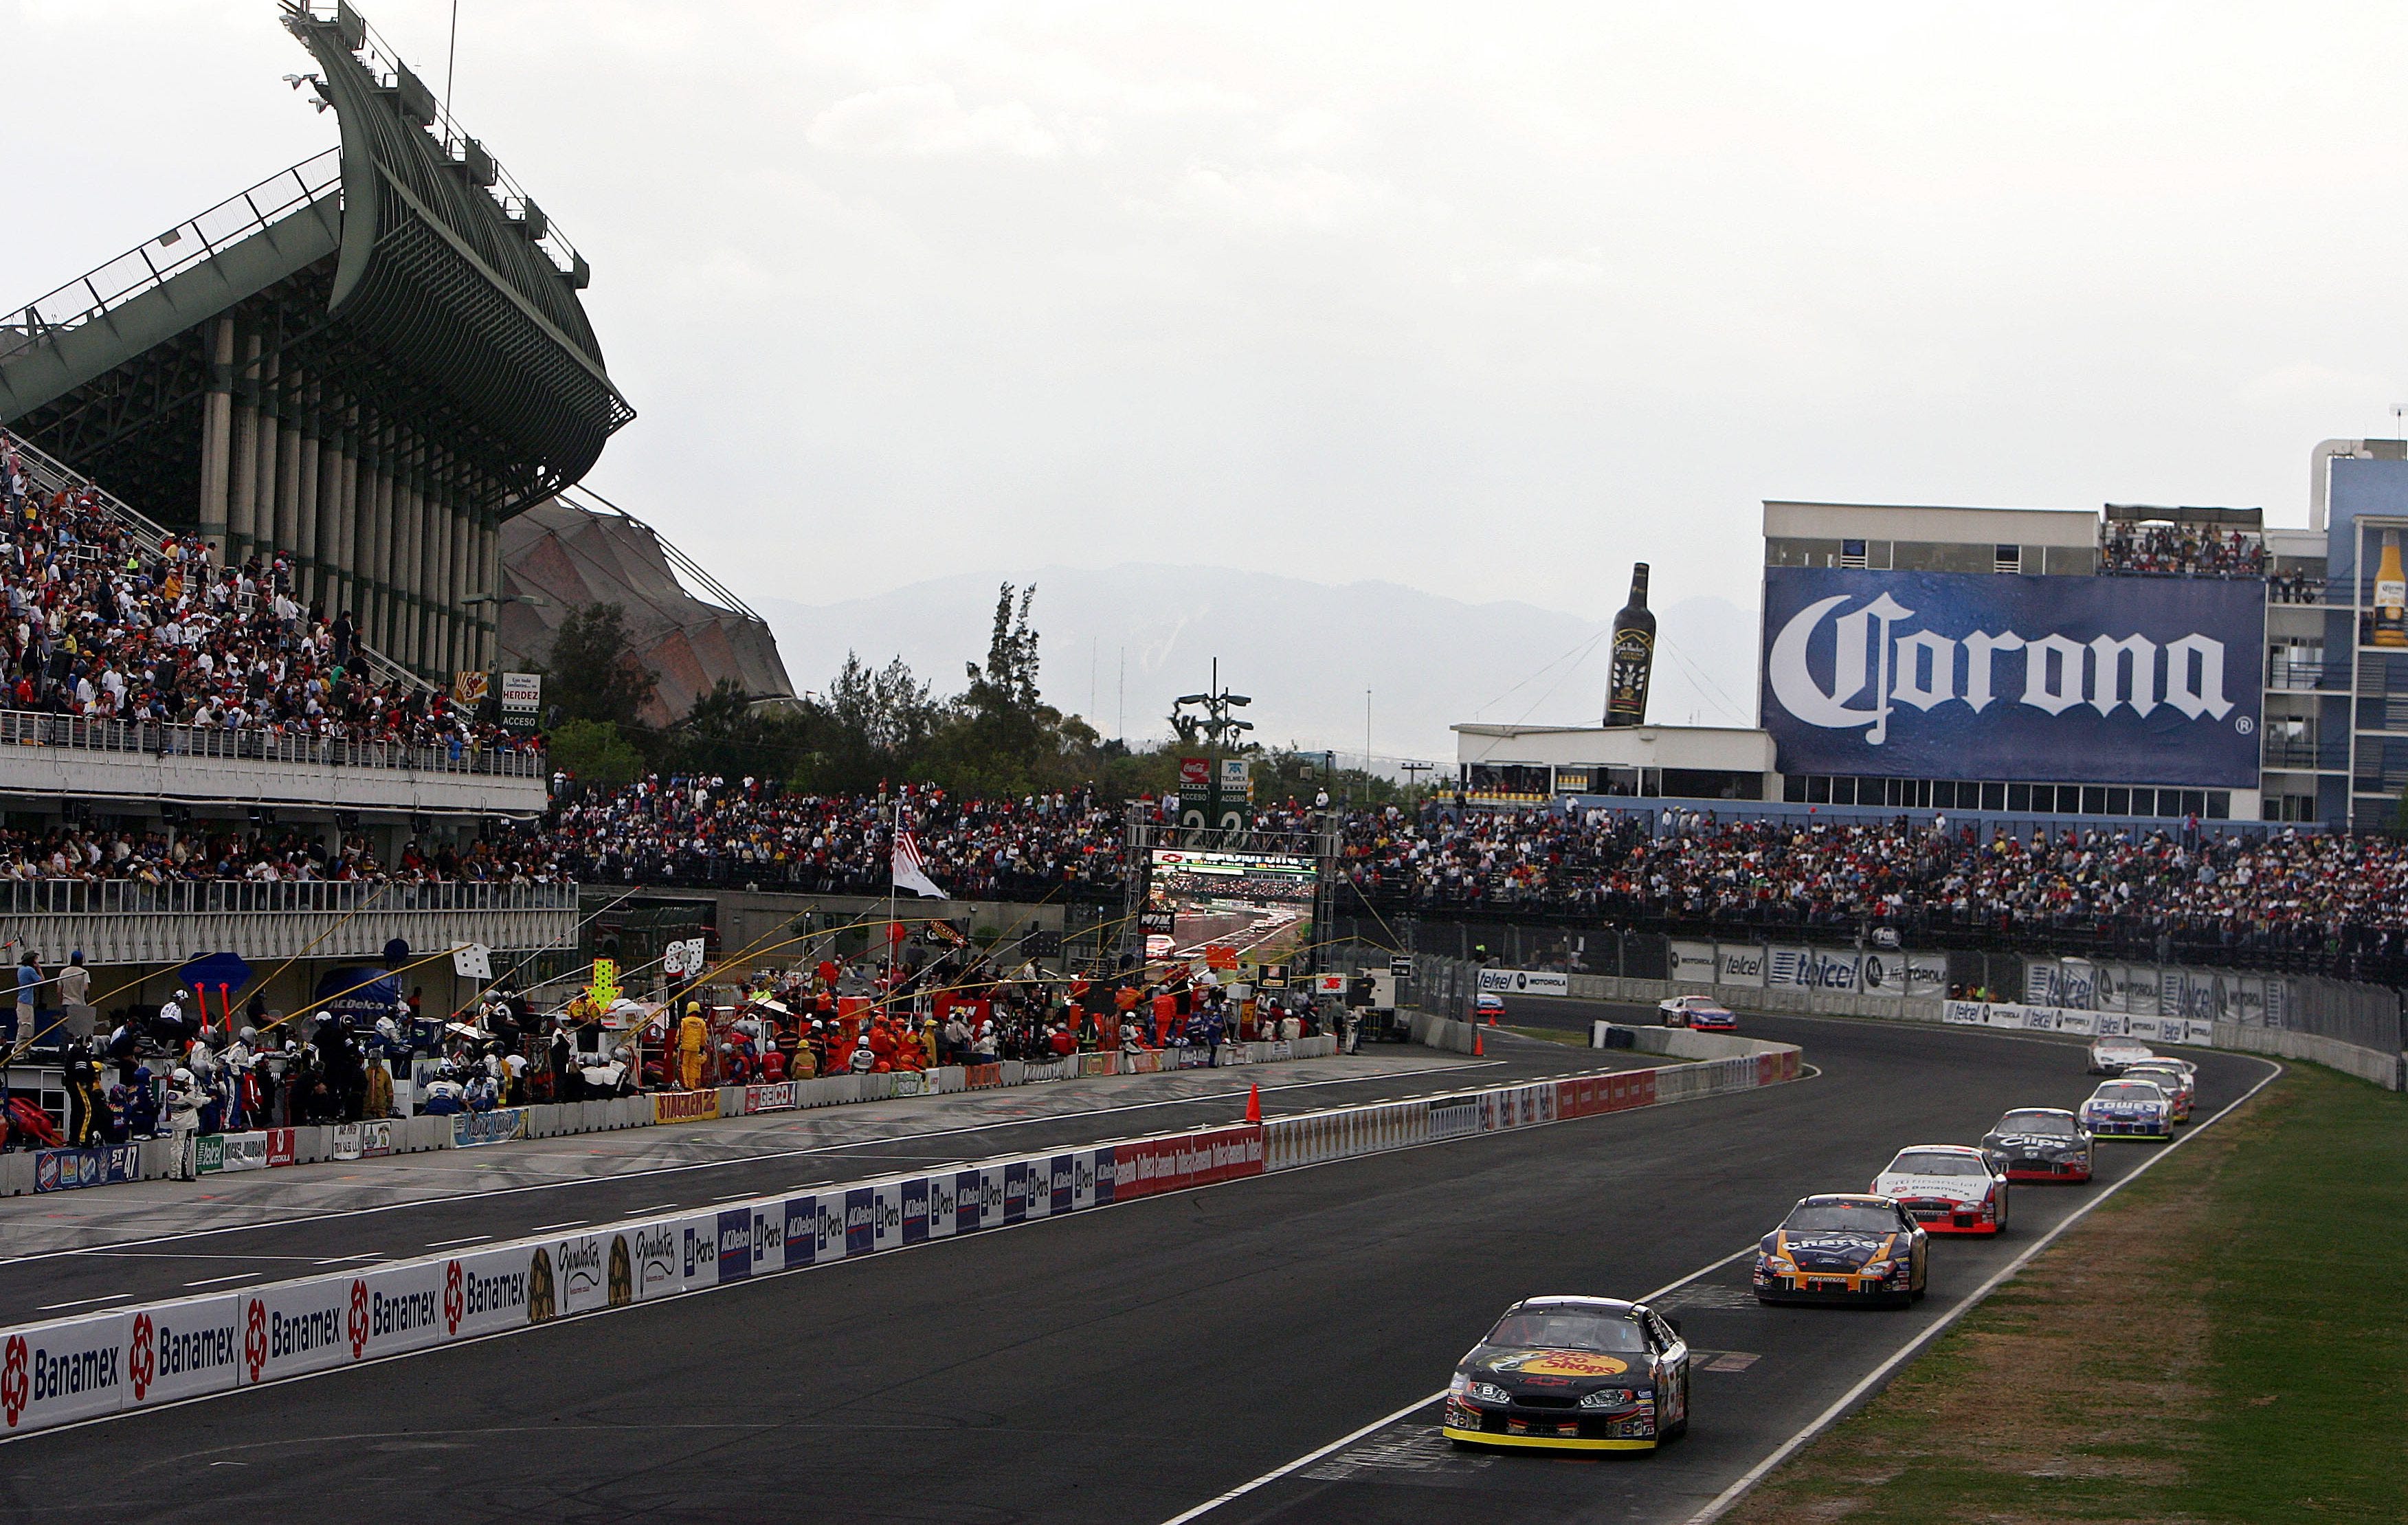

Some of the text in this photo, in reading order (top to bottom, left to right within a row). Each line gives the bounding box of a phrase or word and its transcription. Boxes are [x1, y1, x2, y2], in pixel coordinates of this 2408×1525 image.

[1770, 591, 2235, 745] Corona
[504, 691, 538, 700] HERDEZ
[503, 717, 535, 726] ACCESO
[1181, 793, 1207, 801] ACCESO
[1726, 955, 1763, 975] telcel
[1796, 953, 1858, 989] telcel
[1479, 972, 1513, 989] telcel
[328, 999, 384, 1010] ACDelco
[1954, 1003, 1980, 1021] telcel
[658, 1090, 716, 1120] STACKER 2
[760, 1085, 788, 1106] GEICO
[2000, 1136, 2066, 1148] Clips
[124, 1146, 137, 1179] 47
[203, 1142, 223, 1166] telcel
[1036, 1177, 1049, 1199] Parts
[1082, 1168, 1093, 1189] Parts
[940, 1192, 954, 1215] Parts
[990, 1185, 1001, 1207] Parts
[847, 1205, 873, 1227] ACDelco
[884, 1203, 899, 1228] Parts
[904, 1199, 927, 1218] ACDelco
[764, 1223, 781, 1249] Parts
[788, 1214, 814, 1238] ACDelco
[827, 1212, 843, 1238] Parts
[721, 1227, 750, 1251] ACDelco
[1781, 1238, 1890, 1251] charter
[696, 1239, 714, 1264] Parts
[466, 1271, 525, 1315] Banamex
[373, 1290, 436, 1337] Banamex
[271, 1306, 341, 1358] Banamex
[159, 1326, 235, 1376] Banamex
[34, 1346, 119, 1401] Banamex
[1541, 1360, 1615, 1374] Shops
[1482, 1385, 1493, 1395] 8
